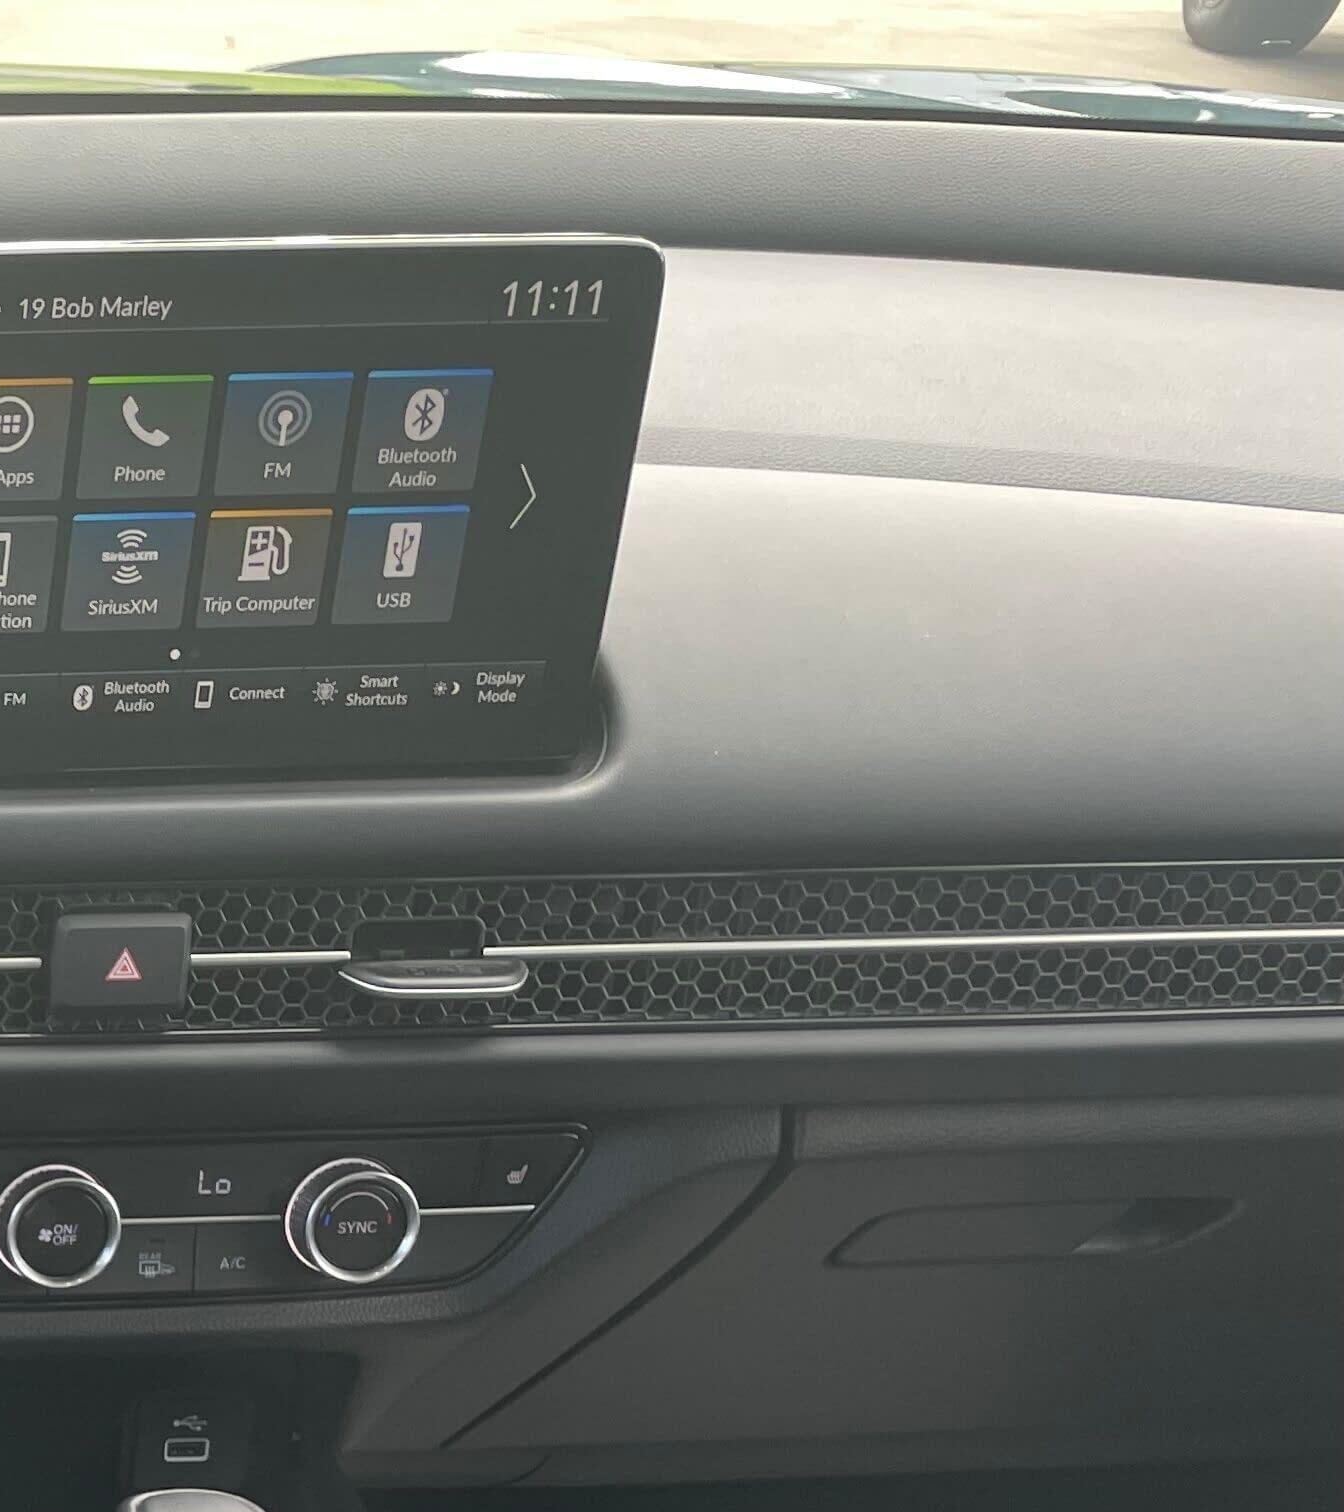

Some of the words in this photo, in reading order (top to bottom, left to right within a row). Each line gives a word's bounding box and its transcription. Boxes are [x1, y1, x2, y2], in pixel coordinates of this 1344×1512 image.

[502, 279, 604, 317] 11:11
[18, 297, 44, 320] 19
[50, 297, 94, 319] Bob
[99, 294, 173, 321] Marley
[377, 447, 457, 465] Bluetooth
[113, 465, 166, 482] Phone
[263, 462, 292, 479] FM
[387, 470, 437, 488] Audio
[87, 598, 159, 617] SiriusXM
[203, 596, 232, 615] Trip
[235, 595, 316, 614] Computer
[376, 592, 412, 608] USB
[103, 680, 170, 696] Bluetooth
[359, 673, 400, 689] Smart
[475, 671, 526, 689] Display
[3, 692, 27, 706] FM
[229, 685, 286, 702] Connect
[345, 690, 408, 708] Shortcuts
[477, 688, 517, 703] Mode
[114, 697, 155, 713] Audio
[52, 1223, 79, 1235] ON/
[336, 1220, 378, 1236] SYNC
[52, 1234, 78, 1246] OFF
[219, 1256, 247, 1271] A/C
